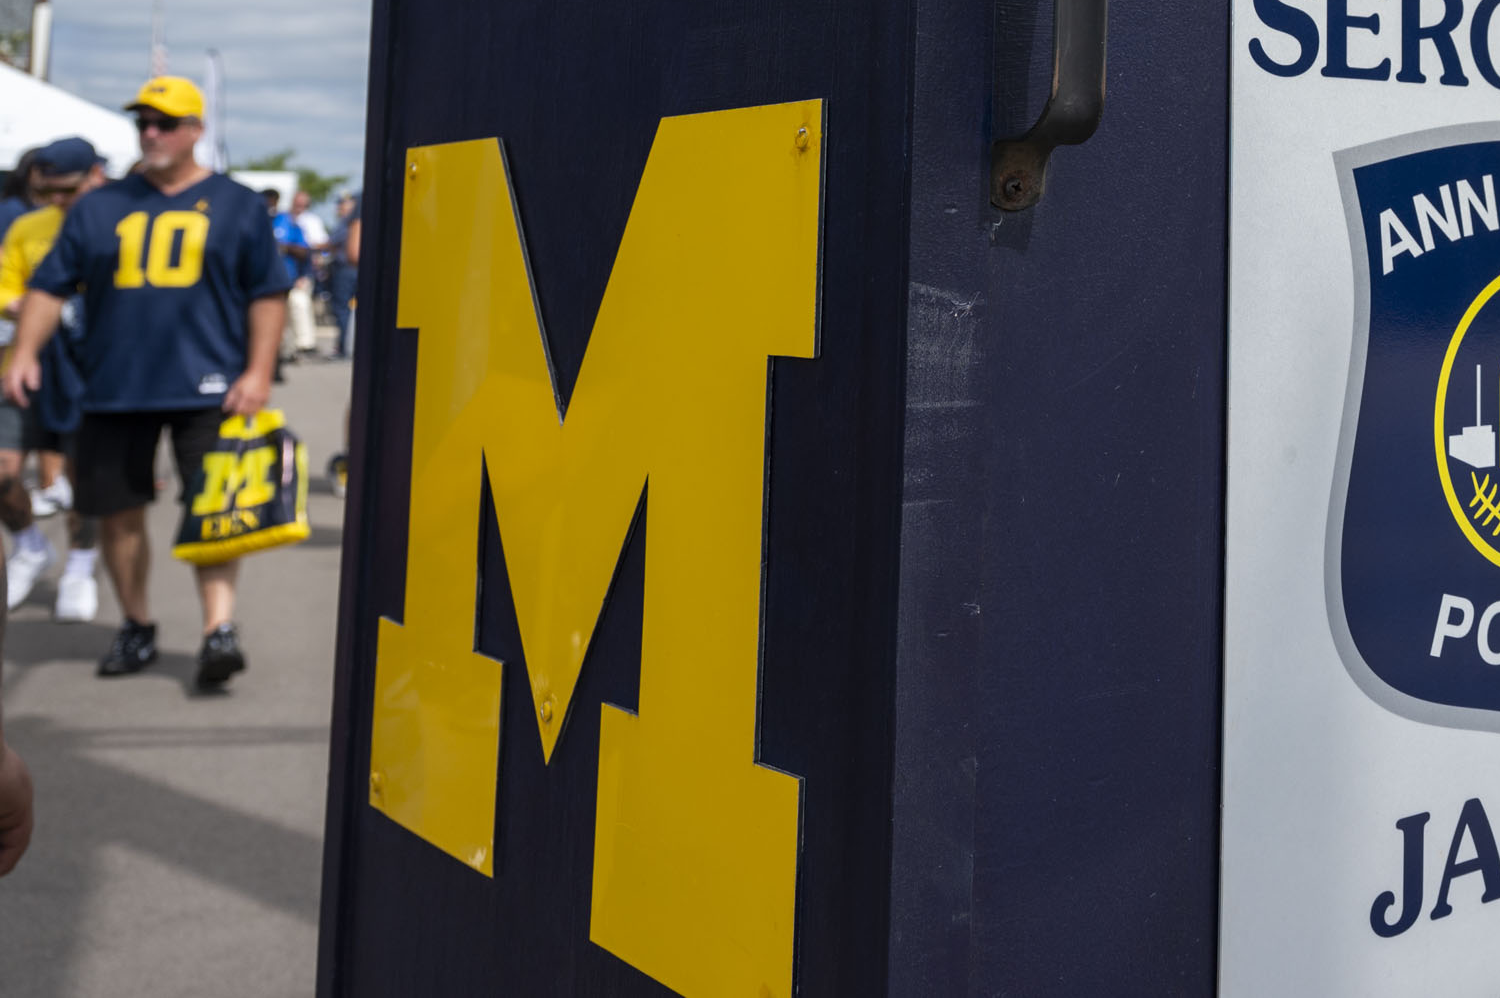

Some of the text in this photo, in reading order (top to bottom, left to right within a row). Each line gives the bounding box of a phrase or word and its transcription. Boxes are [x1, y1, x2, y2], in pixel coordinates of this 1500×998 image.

[113, 210, 210, 289] 10
[1378, 173, 1500, 276] ANN
[191, 445, 277, 517] M
[368, 98, 826, 998] M
